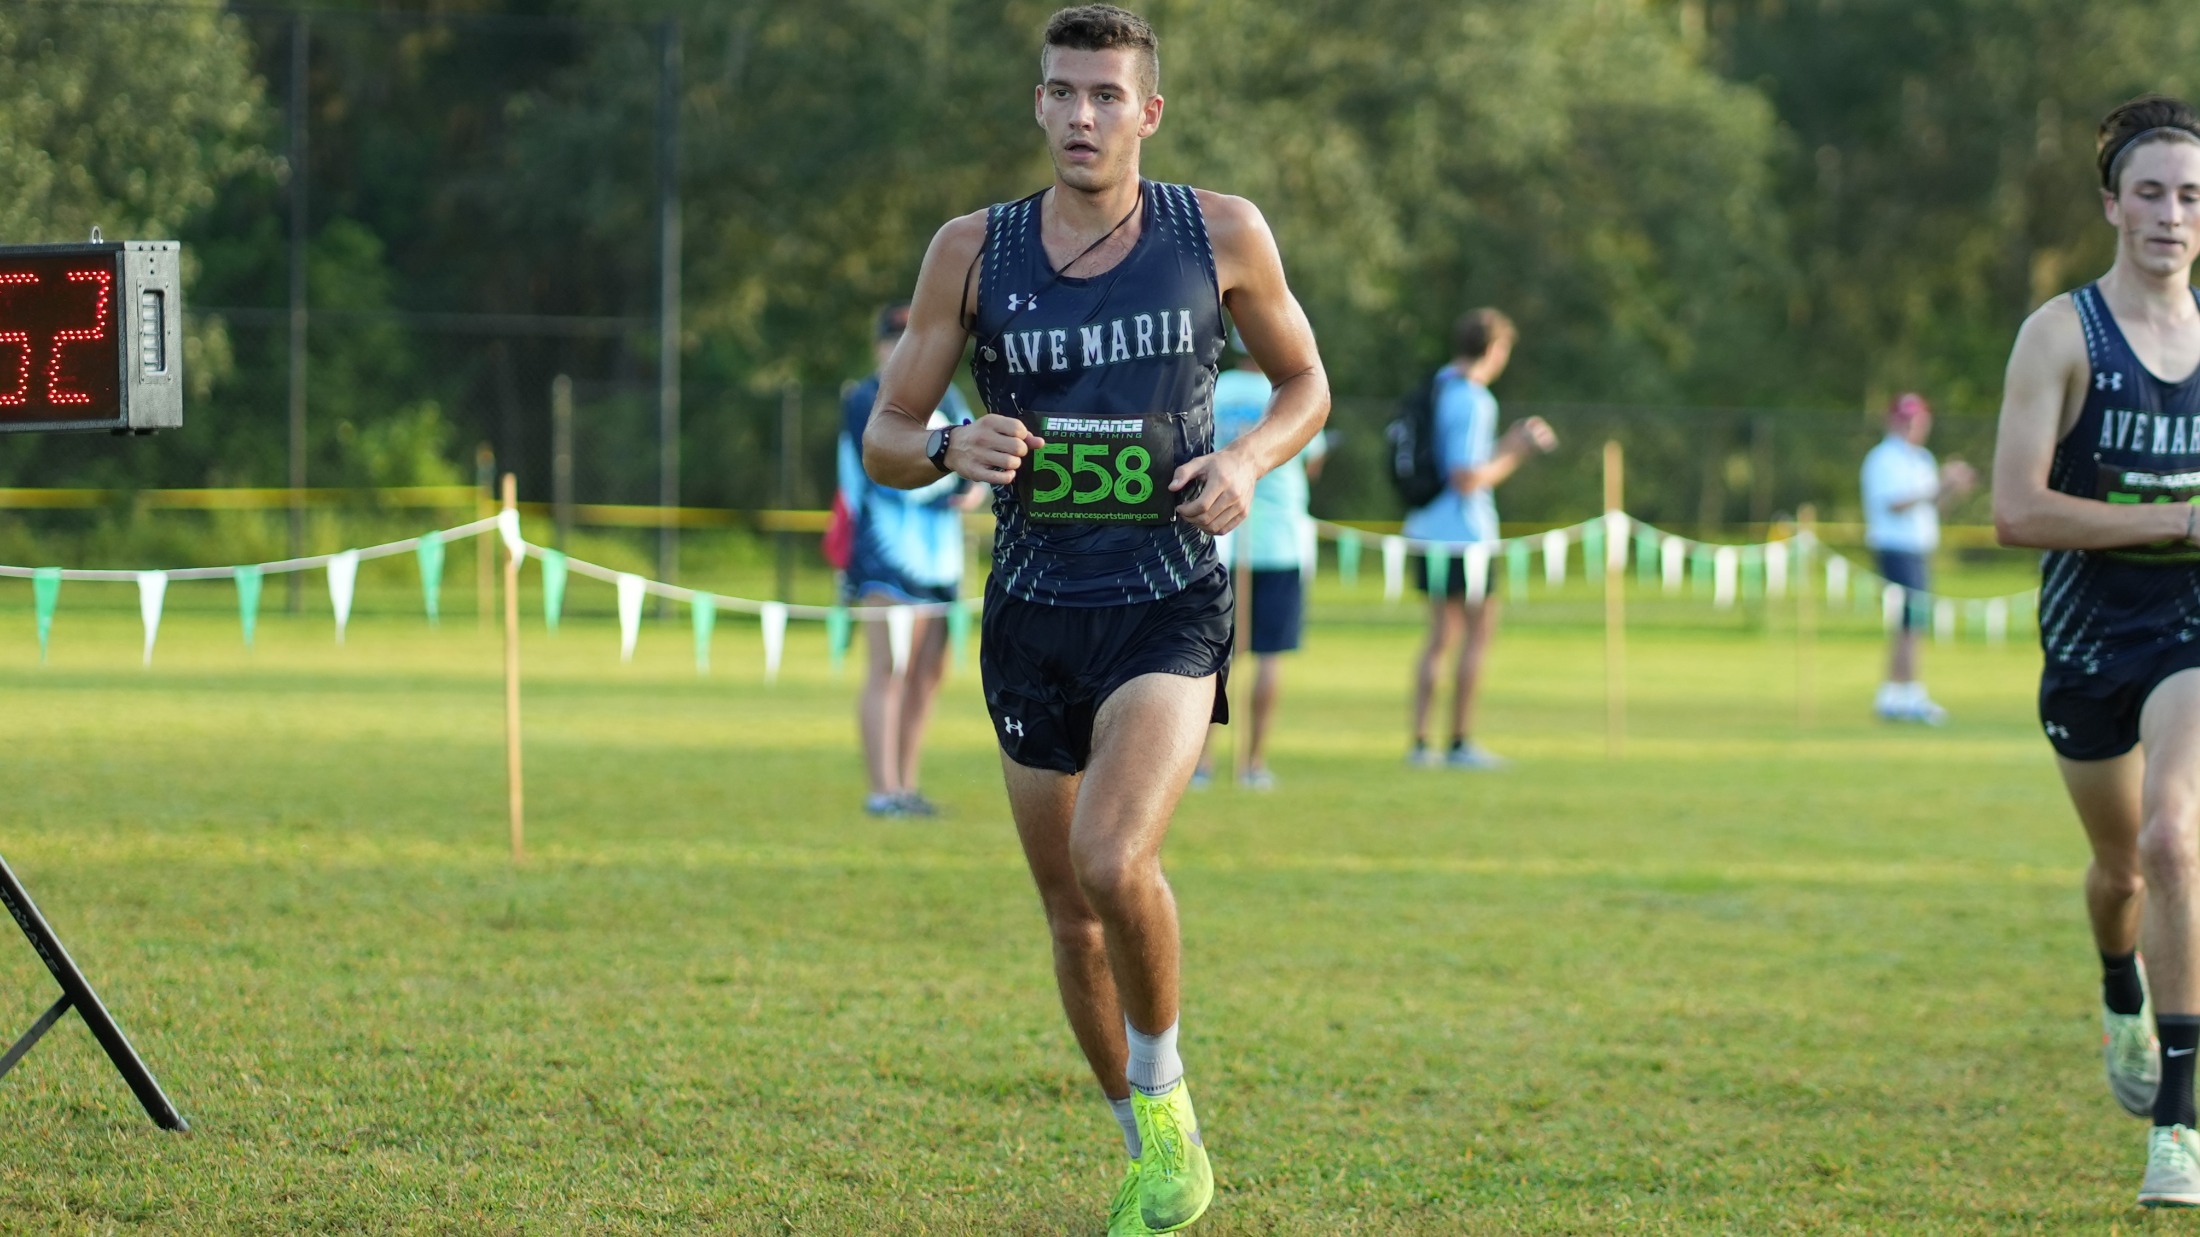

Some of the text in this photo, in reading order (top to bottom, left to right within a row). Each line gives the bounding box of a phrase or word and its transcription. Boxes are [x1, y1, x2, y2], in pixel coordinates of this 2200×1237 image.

[1002, 309, 1195, 374] AVE MARIA
[1044, 430, 1143, 439] SPORTS TIMING
[1045, 417, 1144, 433] ENDURANCE
[2099, 409, 2149, 452] AVE
[1033, 443, 1154, 504] 558
[1029, 511, 1159, 522] www.endurancesportstiming.com
